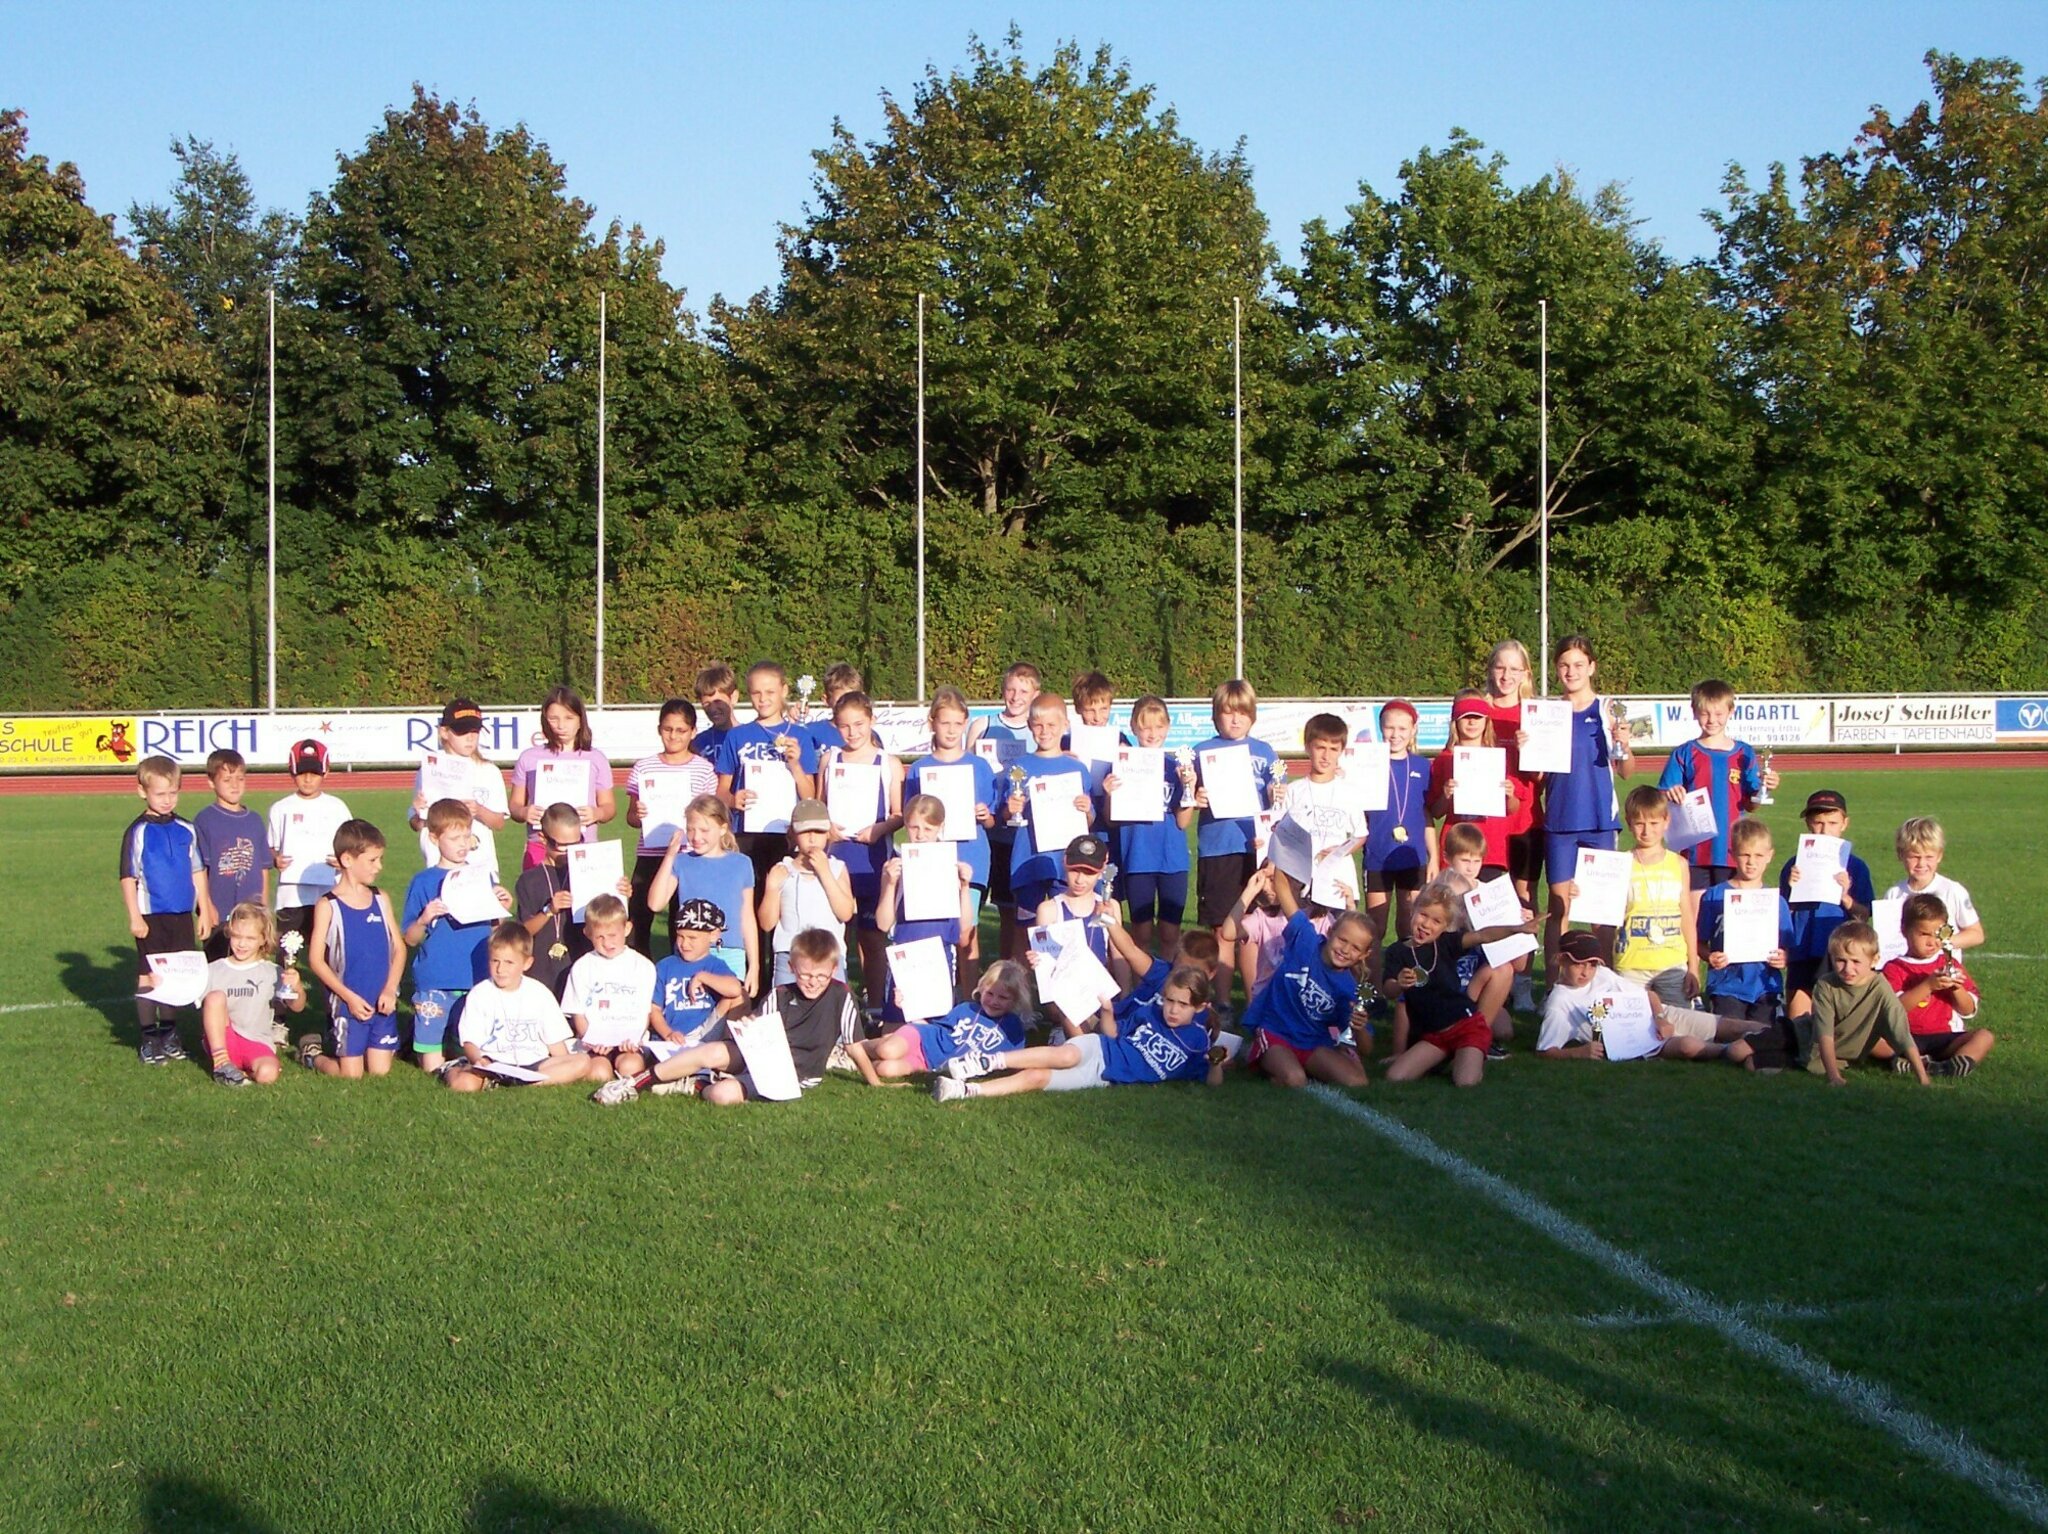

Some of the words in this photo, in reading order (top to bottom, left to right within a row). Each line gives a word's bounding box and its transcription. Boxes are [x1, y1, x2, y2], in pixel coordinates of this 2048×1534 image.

[1693, 704, 1800, 721] MGARTL
[1838, 704, 1895, 724] Josef
[1900, 703, 1991, 721] Schüßler
[143, 719, 257, 761] REICH
[1837, 727, 1886, 741] FARBEN
[1902, 727, 1992, 741] TAPETENHAUS
[0, 737, 73, 753] SCHULE
